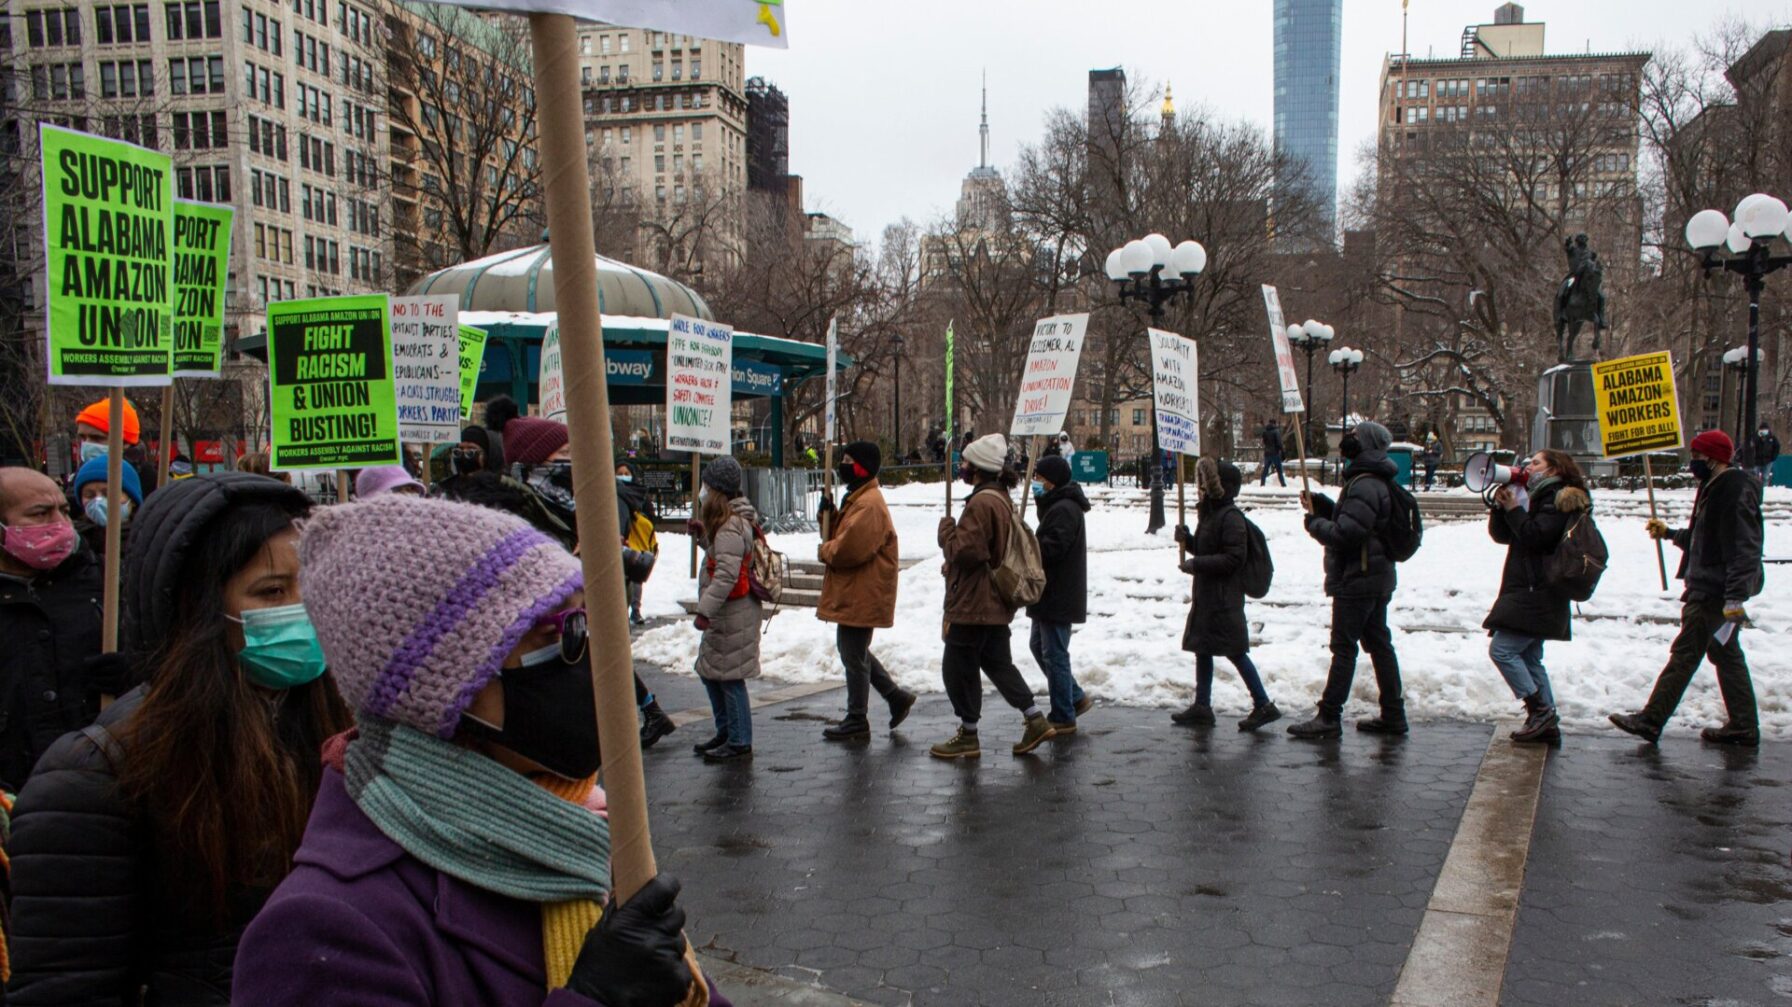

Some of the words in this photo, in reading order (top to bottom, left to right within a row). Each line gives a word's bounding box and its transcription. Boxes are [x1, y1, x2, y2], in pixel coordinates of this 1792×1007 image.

[59, 149, 163, 212] SUPPORT
[60, 203, 166, 262] ALABAMA
[174, 214, 221, 250] PORT
[61, 254, 166, 304] AMAZON
[178, 288, 214, 318] ZON
[392, 303, 406, 317] NO
[409, 303, 419, 316] TO
[423, 303, 444, 317] THE
[274, 315, 301, 325] SUPPORT
[302, 313, 329, 323] ALABAMA
[330, 311, 357, 321] AMAZON
[1063, 322, 1073, 335] TO
[304, 324, 354, 351] FIGHT
[1064, 339, 1075, 352] AL
[63, 353, 98, 363] WORKERS
[394, 343, 433, 358] EMOCRATS
[439, 343, 449, 358] &
[296, 352, 366, 379] RACISM
[395, 365, 452, 380] EPUBLICANS--
[606, 357, 652, 379] bway
[1029, 359, 1058, 373] AMAZON
[1160, 356, 1181, 373] WITH
[731, 366, 745, 383] nion
[747, 368, 772, 387] Square
[1603, 366, 1663, 391] ALABAMA
[292, 385, 307, 410] &
[310, 381, 370, 409] UNION
[1024, 394, 1048, 414] DRIVE!
[1609, 384, 1662, 407] AMAZON
[398, 405, 428, 421] ORKERS
[1606, 401, 1671, 427] WORKERS
[290, 413, 377, 441] BUSTING!
[1608, 429, 1629, 441] FIGHT
[1630, 426, 1645, 438] FOR
[1646, 424, 1657, 434] US
[1658, 422, 1674, 432] ALL!
[278, 449, 309, 458] WORKERS
[310, 446, 340, 456] ASSEMBLY
[341, 444, 370, 454] AGAINST
[371, 443, 394, 453] RACISM
